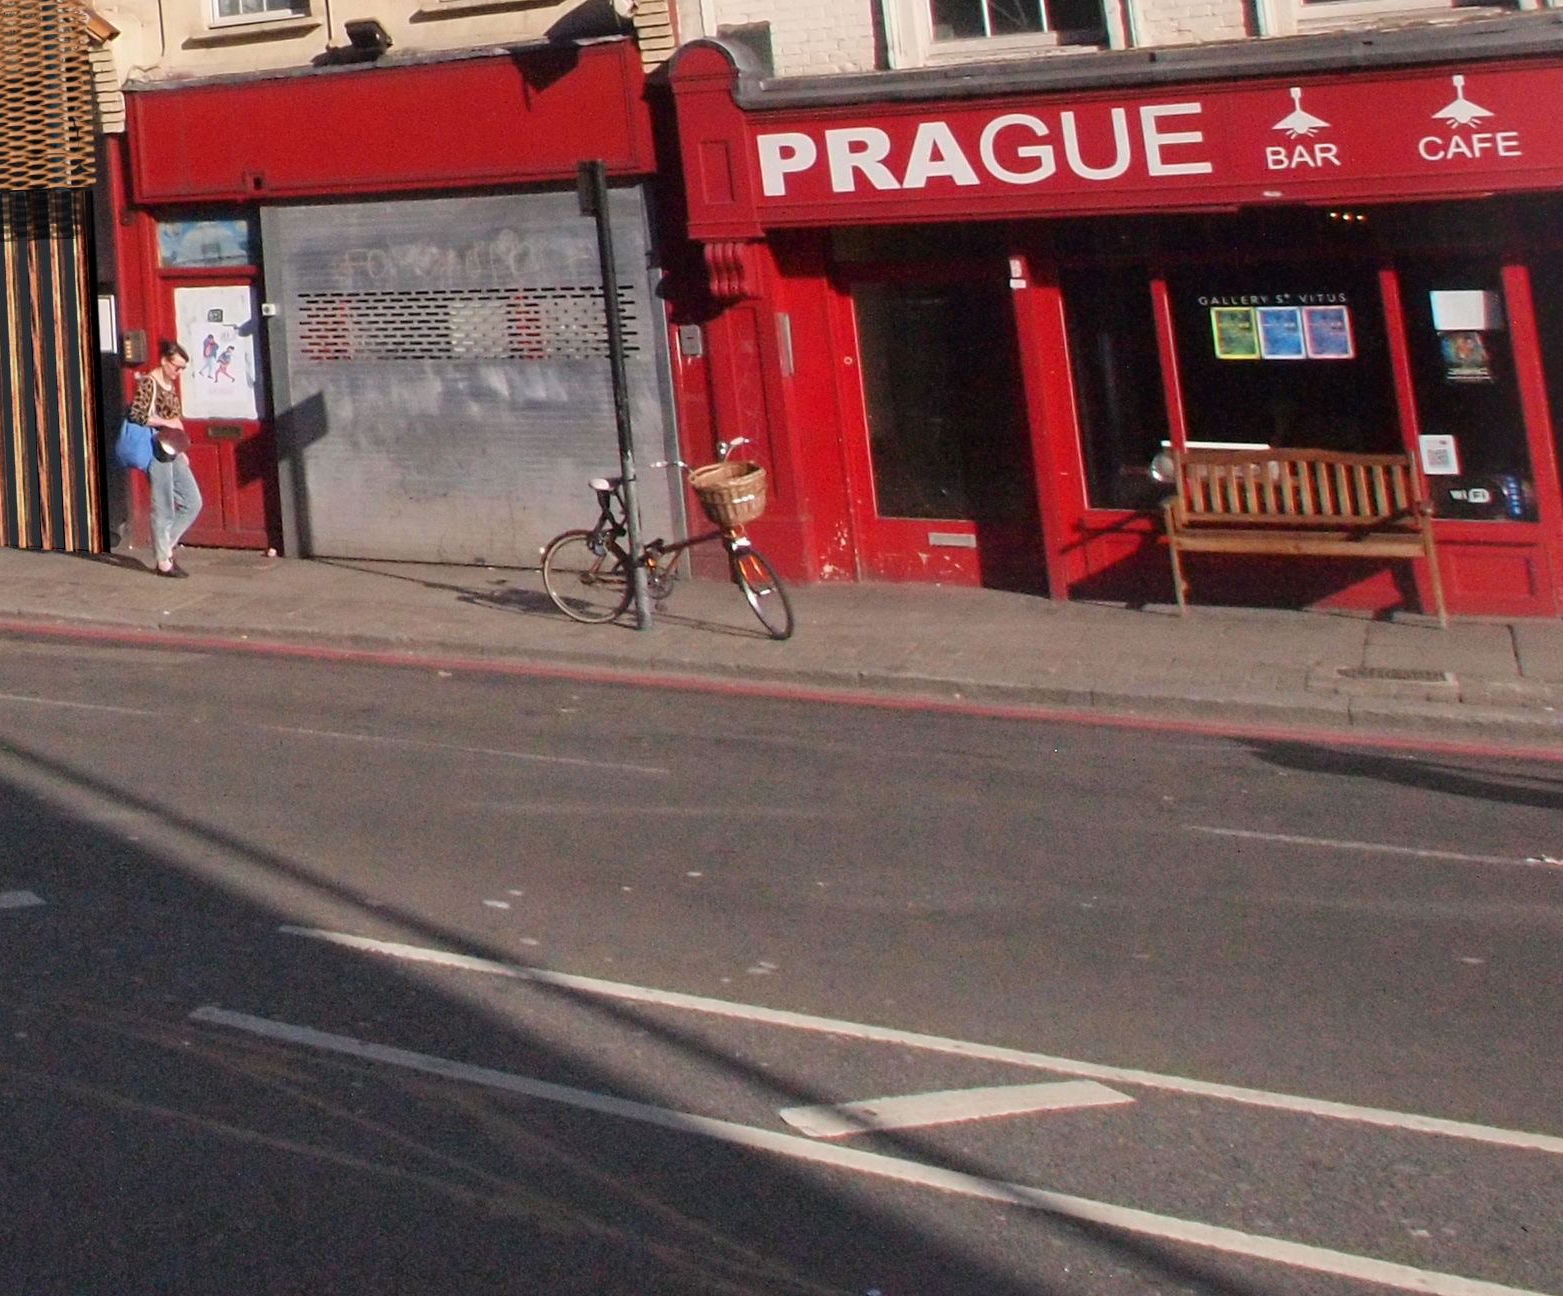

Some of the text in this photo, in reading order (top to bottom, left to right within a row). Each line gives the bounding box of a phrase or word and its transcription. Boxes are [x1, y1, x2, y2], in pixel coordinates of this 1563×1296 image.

[756, 102, 1522, 196] PRAGUE BAR CAFE
[1198, 294, 1268, 306] GALLERY
[1299, 292, 1347, 303] VITUS
